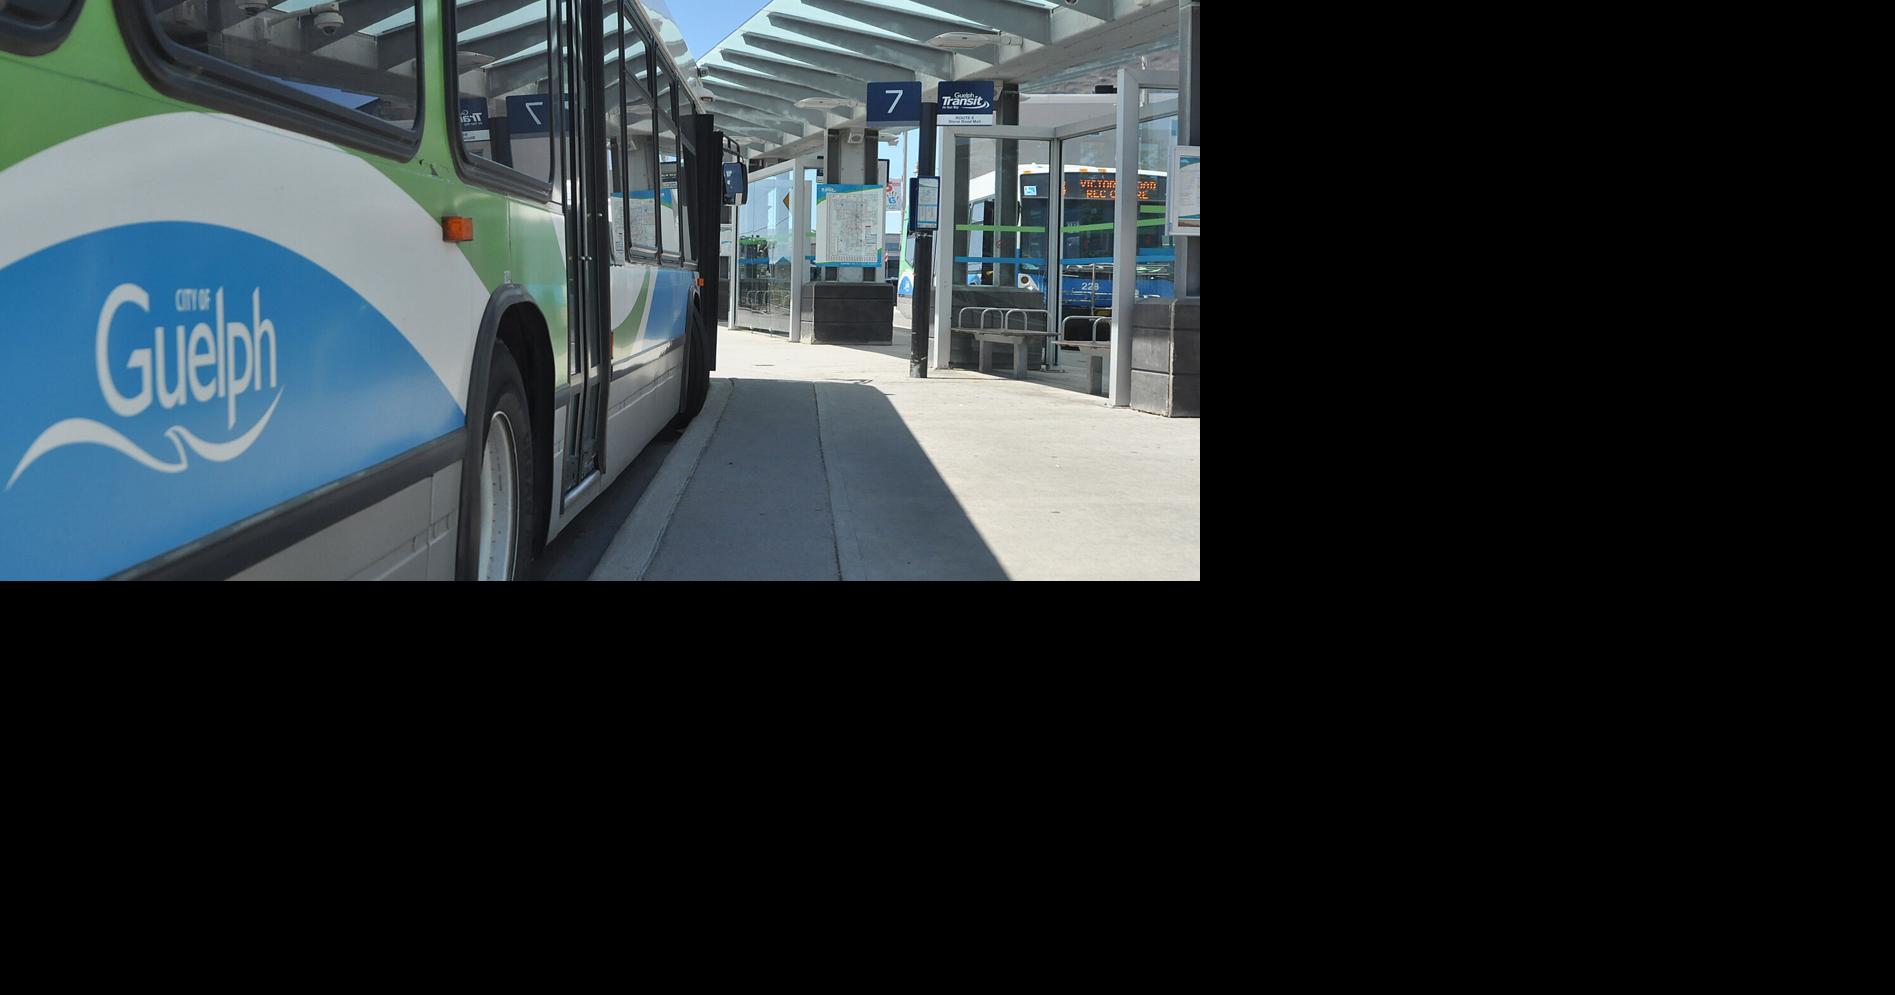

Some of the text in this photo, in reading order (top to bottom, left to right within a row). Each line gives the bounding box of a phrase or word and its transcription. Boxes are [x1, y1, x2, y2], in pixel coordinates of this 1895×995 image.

[885, 89, 903, 114] 7
[942, 96, 983, 106] Transit
[1080, 179, 1118, 189] VICTOR
[1086, 189, 1107, 199] REC
[175, 288, 212, 312] CITY OF
[95, 283, 277, 431] Guelph
